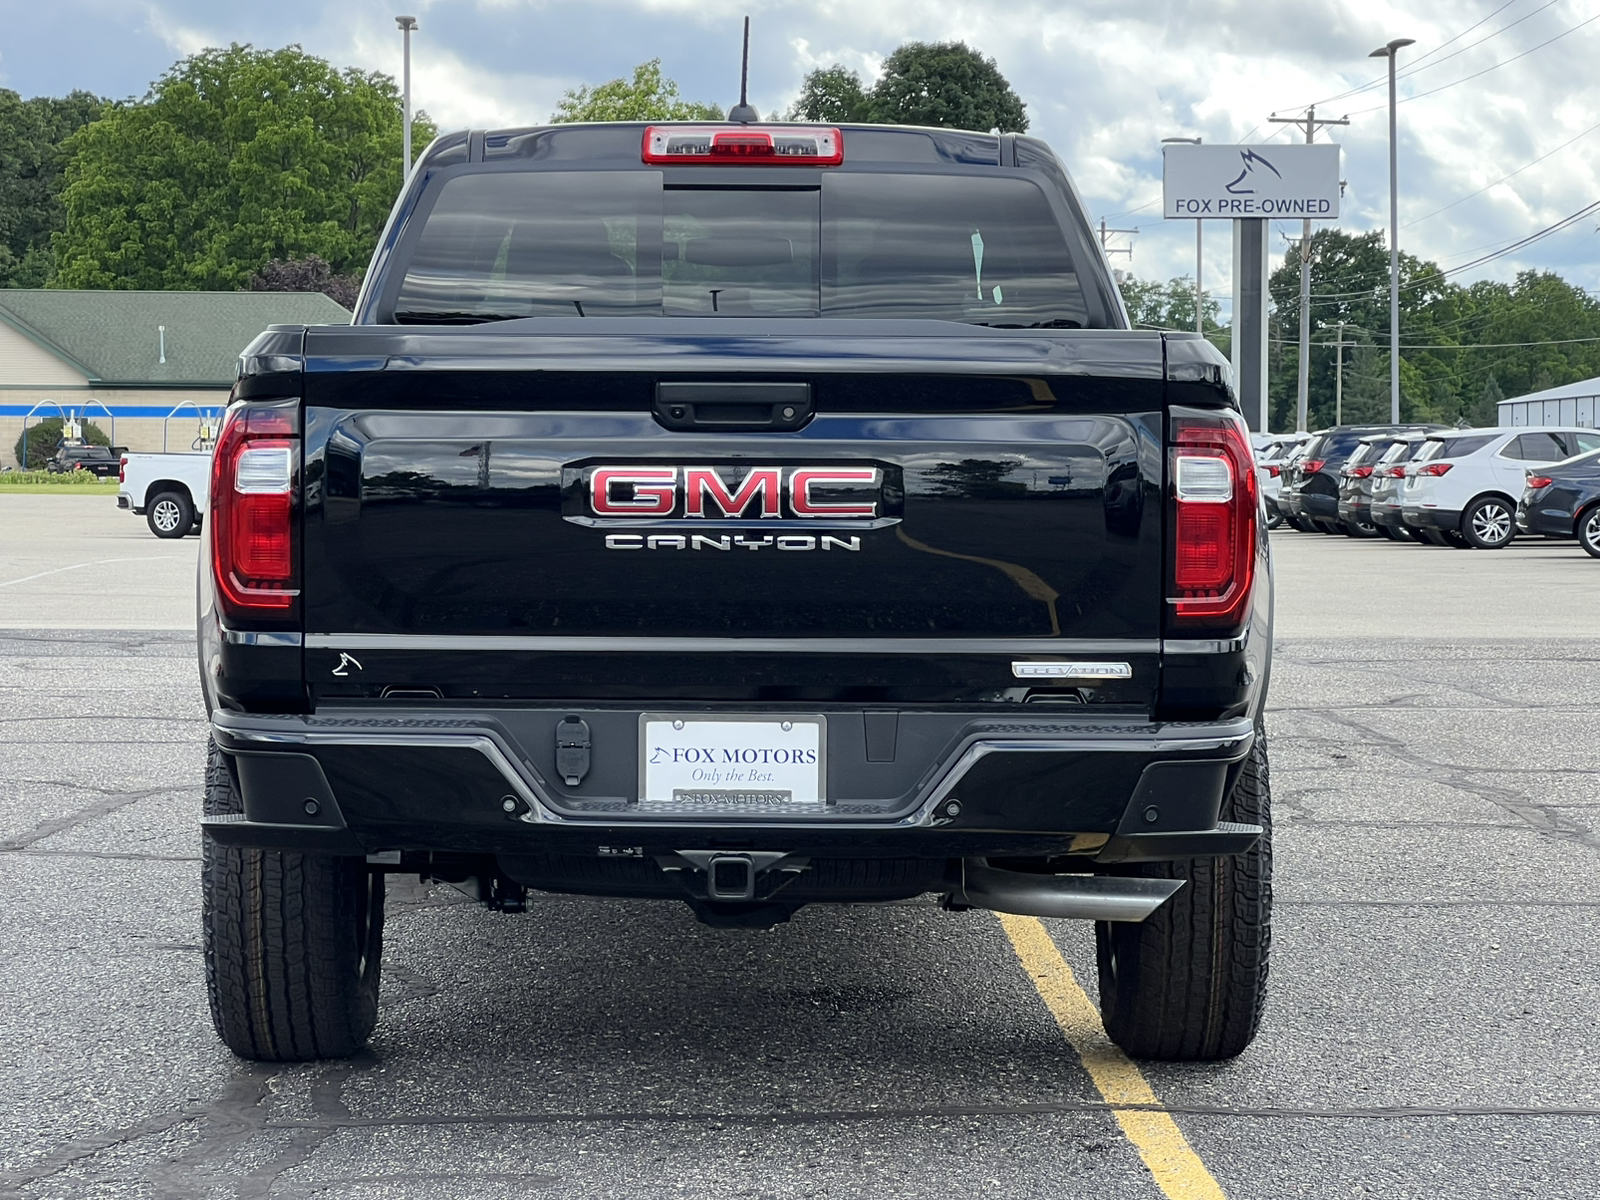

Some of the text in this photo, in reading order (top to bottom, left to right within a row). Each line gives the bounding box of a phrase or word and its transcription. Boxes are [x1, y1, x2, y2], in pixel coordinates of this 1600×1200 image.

[1175, 199, 1331, 213] FOX PRE-OWNED
[590, 466, 878, 519] GMC
[605, 534, 861, 551] CANYON
[1019, 665, 1125, 676] ELEVATION
[672, 748, 817, 764] FOX MOTORS
[691, 768, 775, 785] Only the Best.
